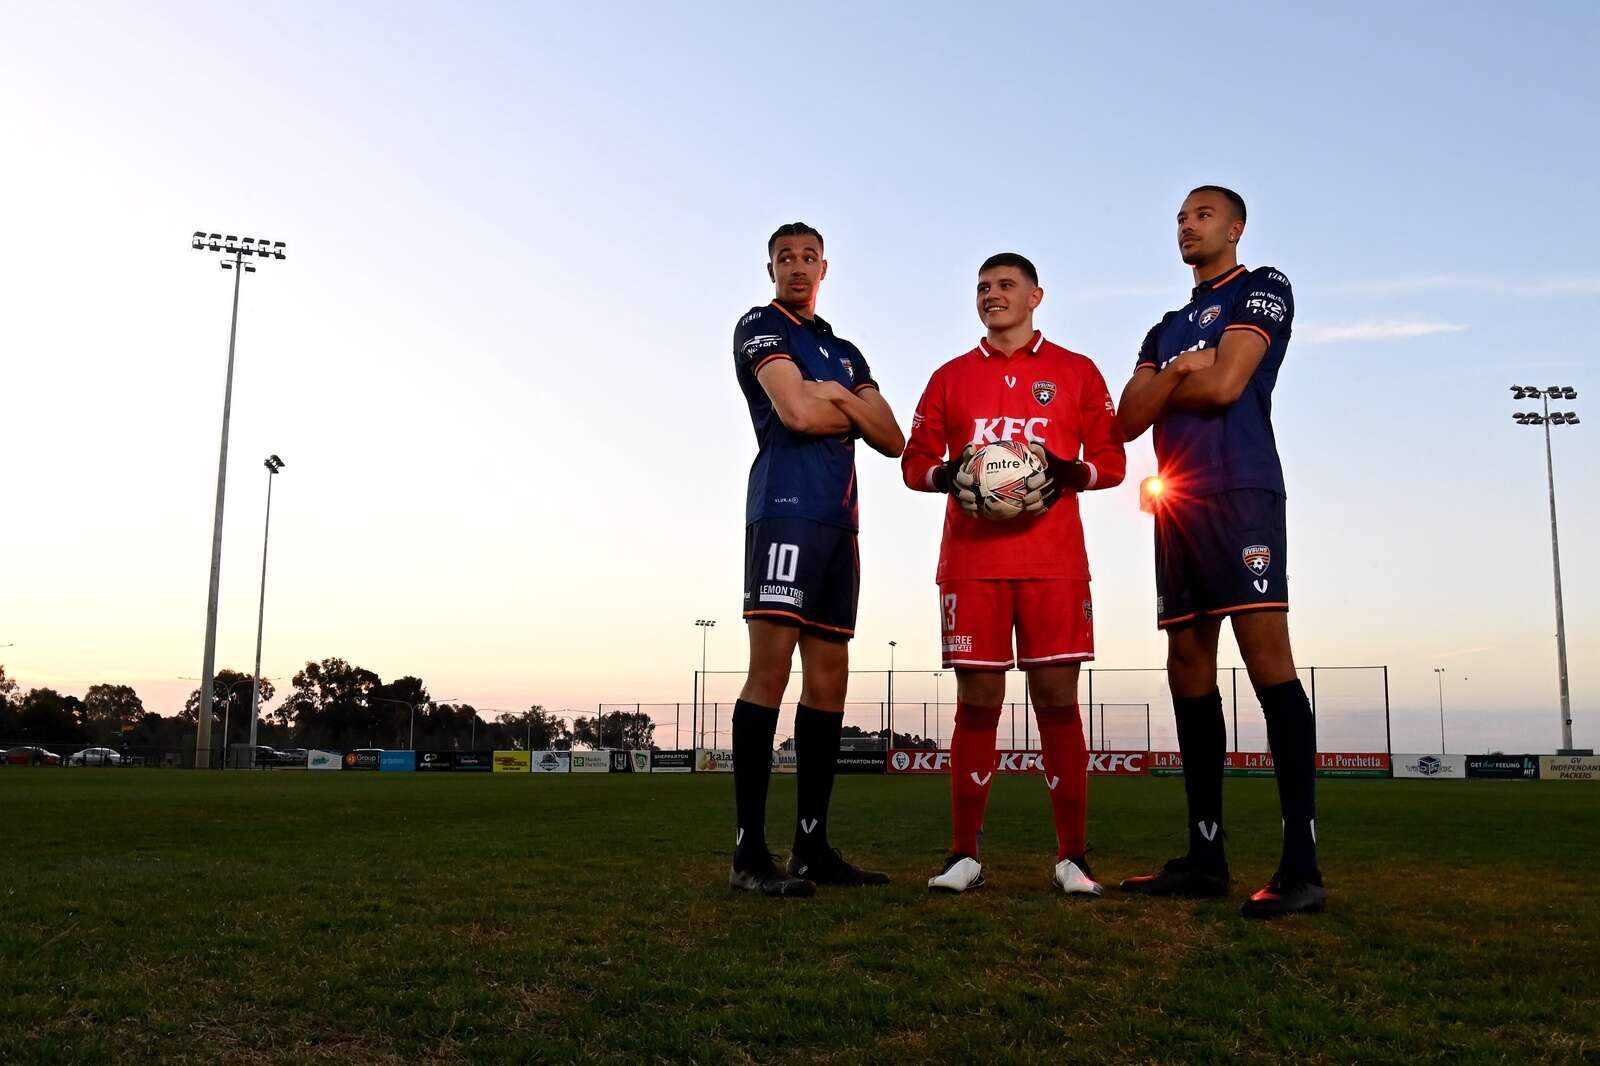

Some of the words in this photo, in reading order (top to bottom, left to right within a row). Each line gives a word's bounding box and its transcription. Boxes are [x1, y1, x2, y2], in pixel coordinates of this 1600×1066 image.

[972, 417, 1049, 444] KFC
[986, 459, 1020, 470] mitre
[767, 543, 799, 582] 10
[760, 585, 788, 595] LEMON
[912, 752, 951, 770] KF
[1087, 753, 1143, 772] KFC
[1155, 754, 1167, 766] La
[1245, 755, 1258, 767] La
[1321, 755, 1333, 767] La
[1335, 755, 1381, 767] Porchetta
[1559, 771, 1592, 779] PACKERS
